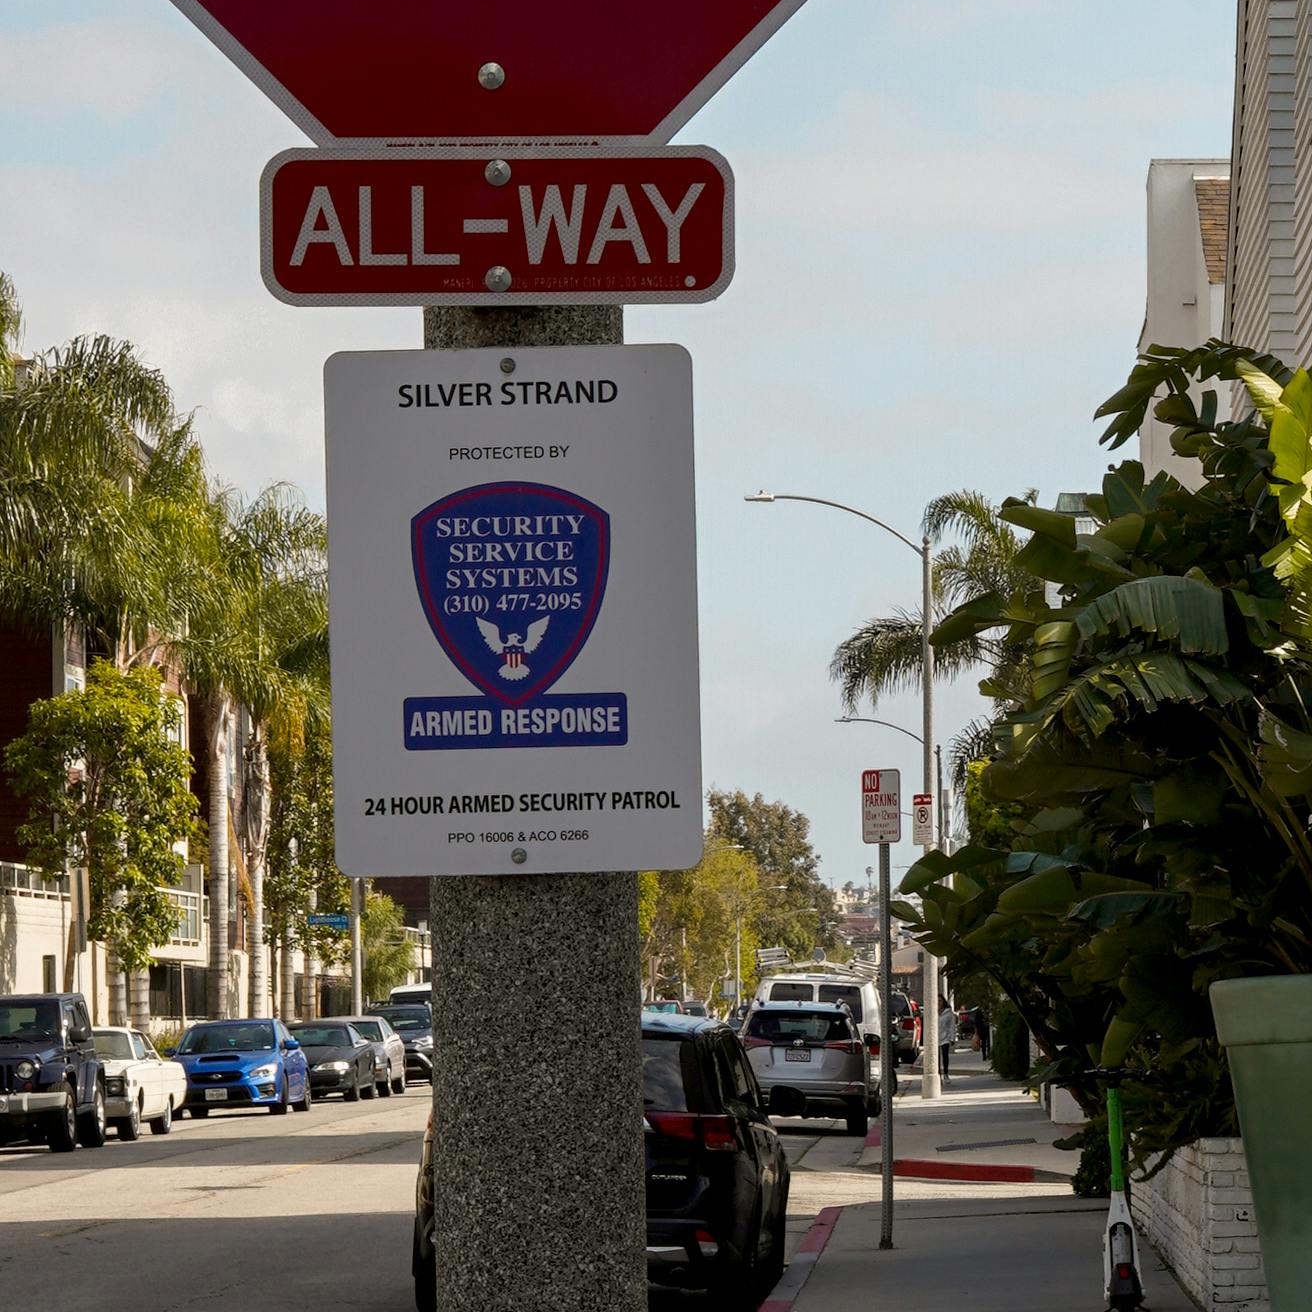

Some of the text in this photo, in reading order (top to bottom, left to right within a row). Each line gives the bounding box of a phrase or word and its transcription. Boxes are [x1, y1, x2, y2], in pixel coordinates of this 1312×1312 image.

[289, 182, 706, 267] ALL-WAY
[397, 378, 619, 409] SILVER STRAND
[449, 445, 570, 461] PROTECTED BY
[436, 515, 586, 537] SECURITY
[449, 541, 575, 564] SERVICE
[445, 566, 579, 590] SYSTEMS
[443, 592, 582, 616] (310) 477-2095
[410, 706, 621, 738] ARMED RESPONSE
[864, 773, 878, 790] NO
[364, 790, 681, 817] 24 HOUR ARMED SECURITY PATROL
[864, 792, 898, 808] PARKING
[447, 829, 590, 844] PPO 16006 & ACO 6266
